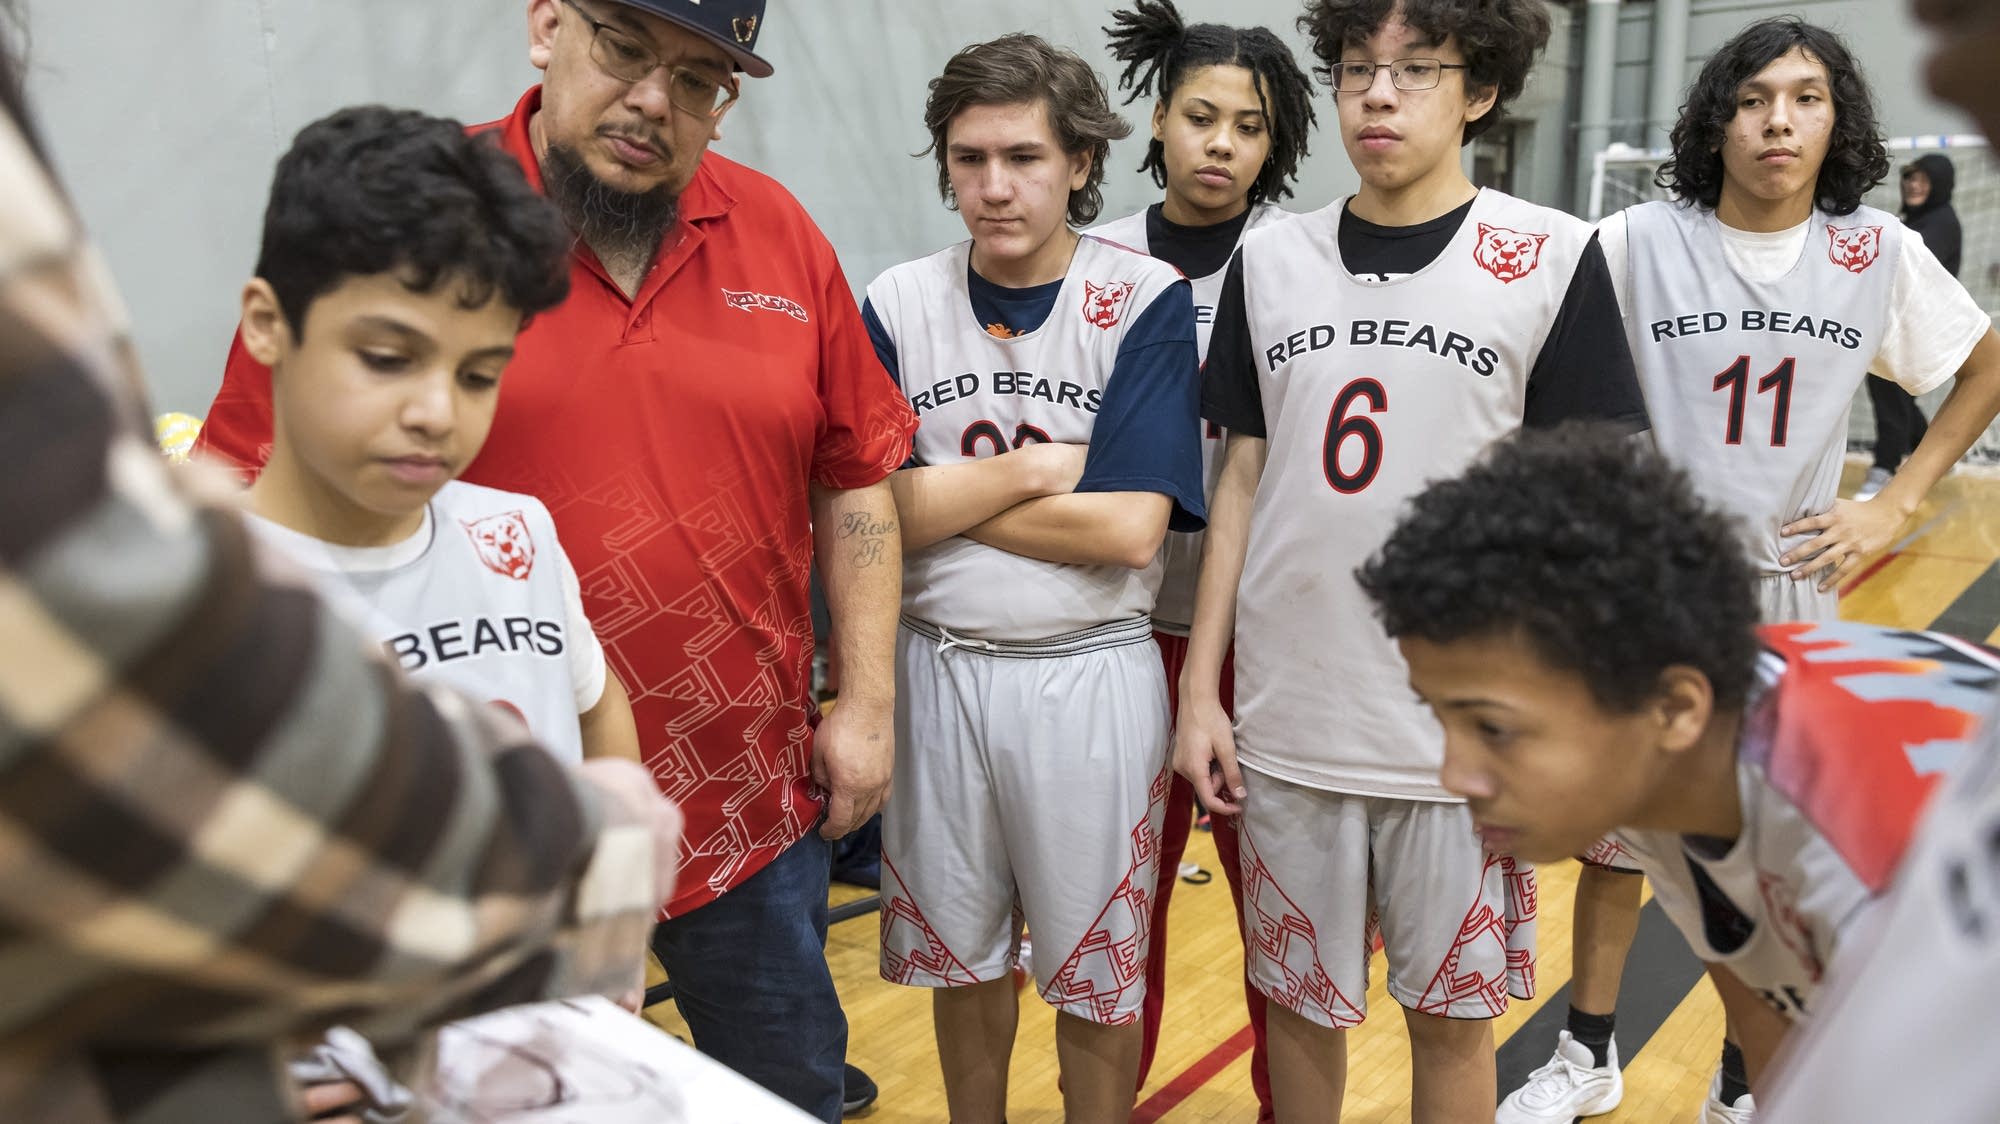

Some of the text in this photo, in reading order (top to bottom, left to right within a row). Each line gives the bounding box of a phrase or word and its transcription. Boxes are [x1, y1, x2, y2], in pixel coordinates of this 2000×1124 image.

[1265, 319, 1500, 378] RED BEARS
[1651, 310, 1863, 350] RED BEARS
[911, 371, 1102, 417] RED BEARS
[1712, 355, 1796, 447] 11
[1322, 377, 1388, 495] 6
[836, 511, 897, 539] Rose
[383, 616, 564, 671] BEARS
